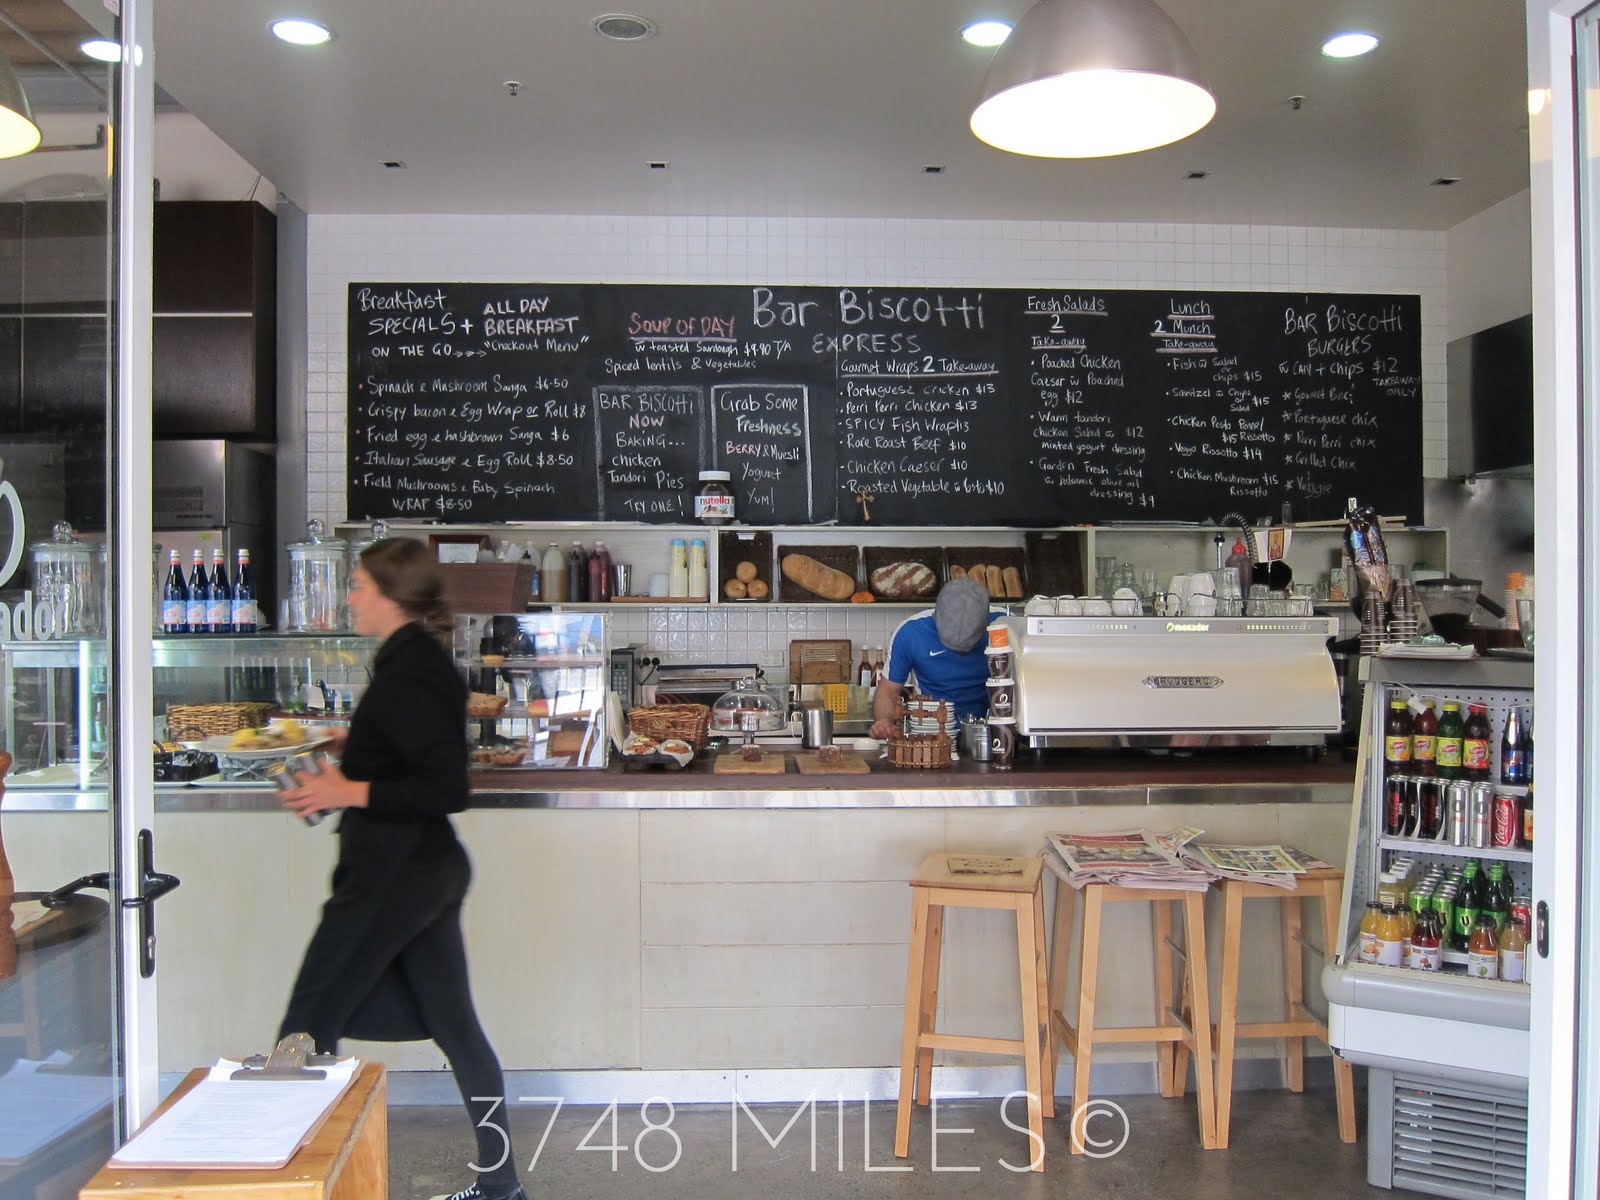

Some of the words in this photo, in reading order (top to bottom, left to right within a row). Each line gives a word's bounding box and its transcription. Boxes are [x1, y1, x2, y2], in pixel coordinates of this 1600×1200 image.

[358, 288, 447, 312] Breakfast
[483, 300, 515, 315] ALL
[520, 297, 549, 314] DAY
[752, 287, 819, 328] Bar
[840, 288, 984, 329] Biscotti
[1028, 296, 1061, 311] Fresh
[1063, 295, 1105, 312] Salads
[1171, 299, 1210, 314] Lunch
[368, 313, 456, 335] SPECIALS
[484, 316, 580, 336] BREAKFAST
[701, 315, 736, 337] DAY
[1051, 315, 1063, 329] 2
[1154, 320, 1166, 333] 2
[1173, 320, 1210, 334] Munch
[372, 347, 389, 357] ON
[399, 346, 424, 356] THE
[433, 343, 452, 356] GO
[649, 342, 690, 352] toasted
[812, 333, 921, 353] EXPRESS
[1308, 334, 1371, 357] BURGERS
[605, 358, 640, 376] Spiced
[646, 357, 682, 371] lentils
[691, 358, 702, 369] &
[705, 359, 756, 372] Vegetables
[886, 359, 919, 378] Wraps
[923, 356, 935, 372] 2
[1173, 358, 1196, 370] Fish
[1212, 357, 1238, 366] Salad
[1372, 356, 1398, 374] $12
[1244, 371, 1262, 382] $15
[367, 376, 414, 396] Spinach
[432, 379, 487, 392] Mushroom
[493, 374, 527, 398] Sanga
[976, 384, 995, 395] $13
[1386, 388, 1416, 397] ONLY
[599, 394, 631, 411] BAR
[720, 392, 760, 412] Grab
[765, 392, 798, 411] Some
[846, 401, 868, 414] Perri
[955, 400, 977, 412] $13
[1040, 392, 1058, 408] egg
[1252, 396, 1269, 407] $15
[368, 402, 406, 420] Crispy
[461, 402, 482, 422] Egg
[487, 402, 523, 421] Wrap
[526, 406, 538, 415] or
[545, 400, 569, 418] Roll
[572, 405, 586, 418] $8
[629, 413, 664, 428] NOW
[737, 414, 802, 437] Freshness
[845, 418, 885, 430] SPICY
[892, 417, 920, 432] Fish
[1172, 416, 1206, 428] Chicken
[367, 426, 398, 442] Fried
[406, 433, 427, 450] egg
[445, 430, 503, 442] hashbrown
[509, 427, 542, 445] Sanga
[847, 433, 872, 448] Rare
[875, 436, 906, 448] Roast
[912, 436, 941, 453] Beef
[948, 442, 966, 451] $10
[1243, 446, 1262, 461] $14
[364, 451, 410, 466] Italian
[412, 454, 456, 471] Sausage
[477, 454, 500, 474] Egg
[503, 452, 532, 467] Roll
[847, 459, 895, 474] Chicken
[951, 460, 968, 470] $10
[1084, 461, 1109, 474] Fresh
[364, 473, 392, 488] Field
[397, 478, 458, 491] Mushrooms
[504, 483, 555, 498] Spinach
[607, 470, 646, 483] Tandori
[656, 470, 684, 490] Pies
[902, 479, 950, 498] Vegetable
[392, 498, 430, 510] WRAP
[700, 496, 730, 504] nutella
[1090, 488, 1133, 505] dressing
